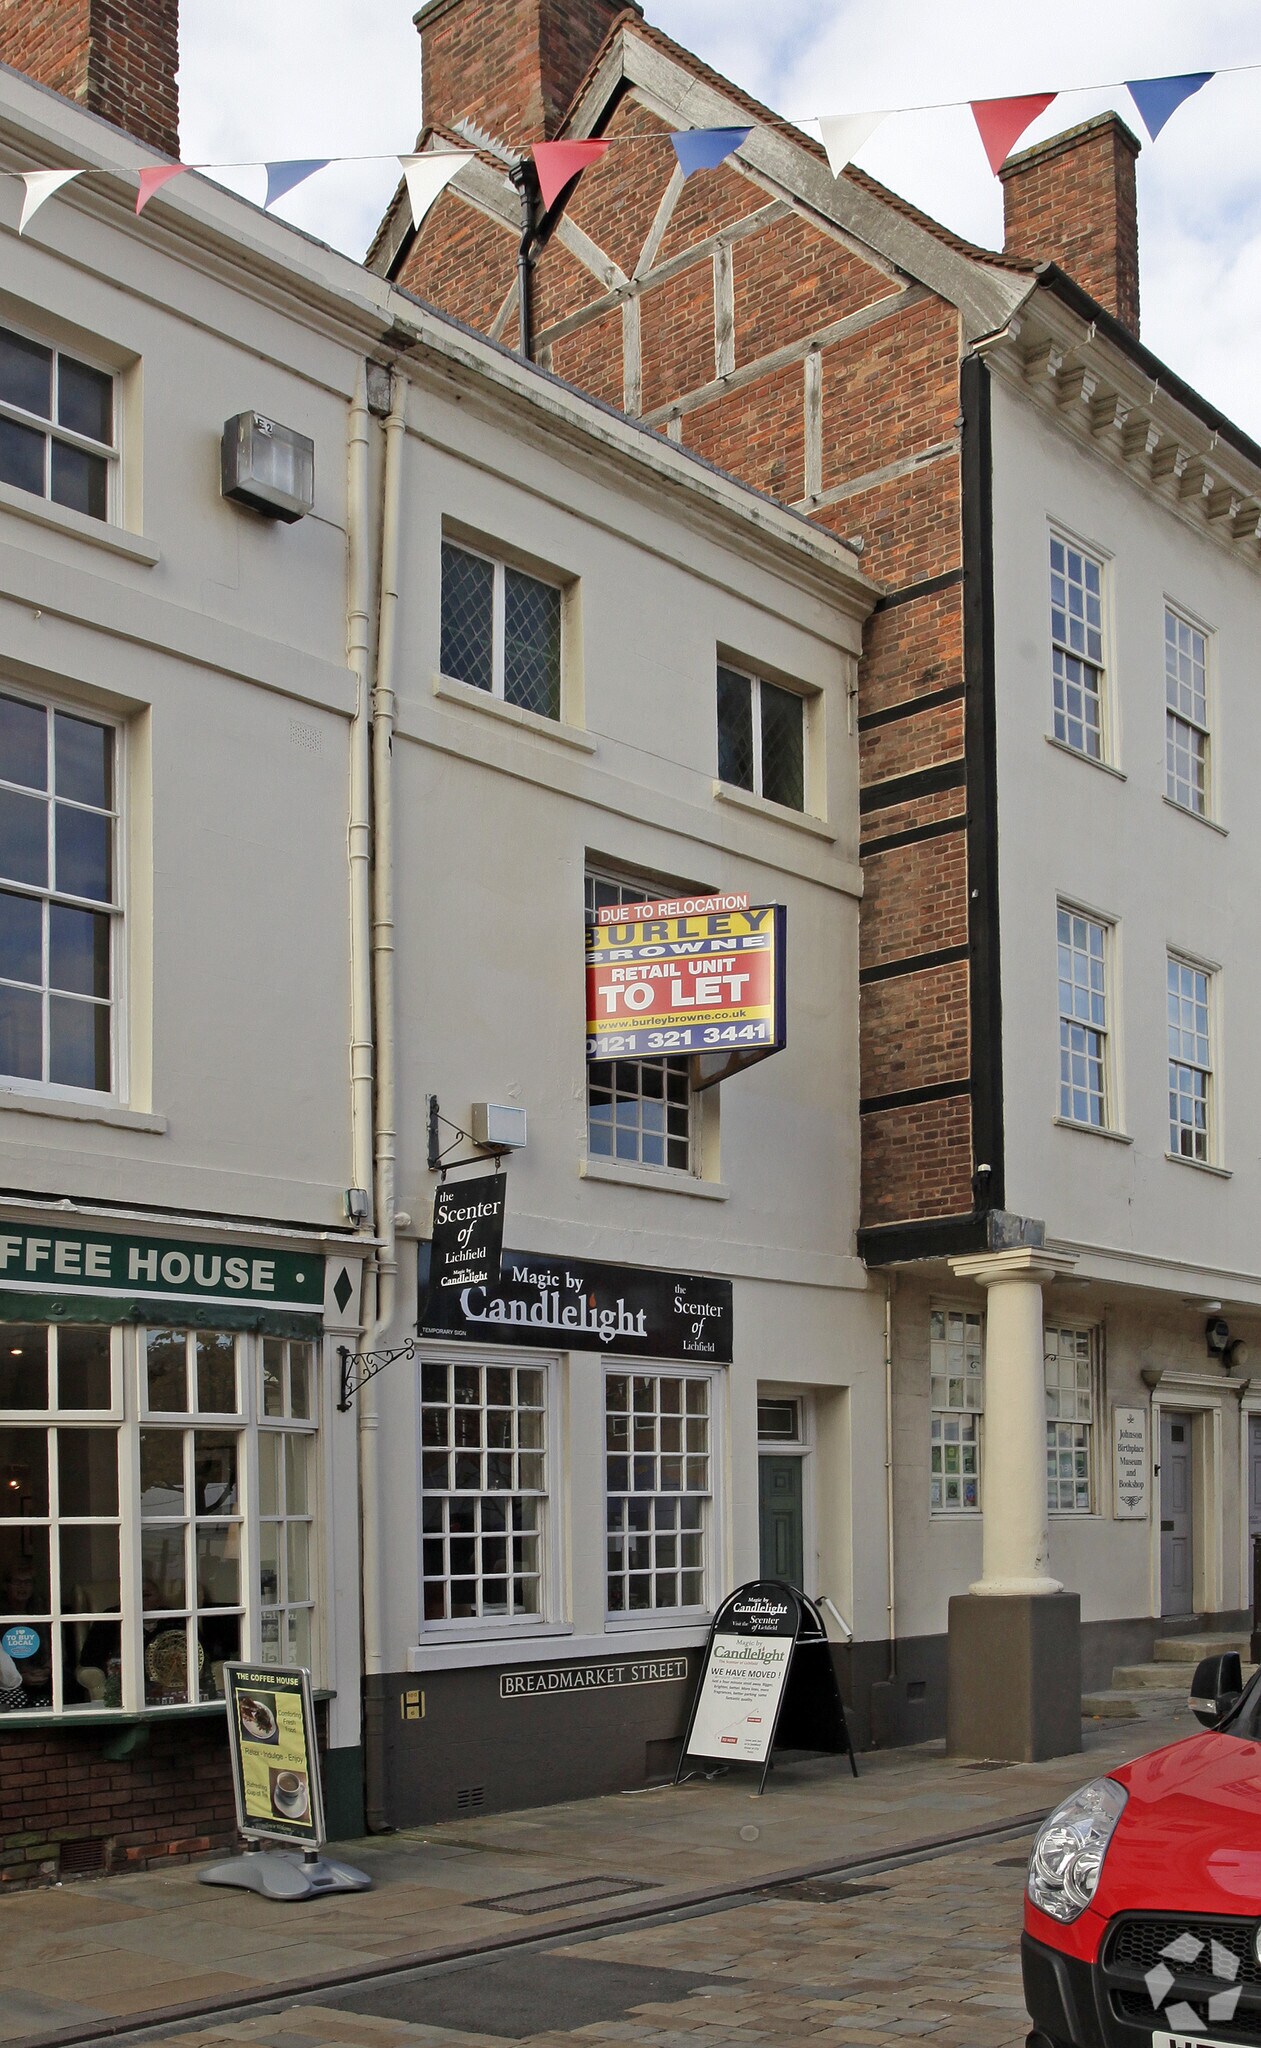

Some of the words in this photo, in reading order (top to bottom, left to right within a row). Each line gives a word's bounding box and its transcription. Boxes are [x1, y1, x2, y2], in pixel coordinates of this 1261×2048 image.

[601, 908, 630, 923] DUE
[634, 905, 653, 919] TO
[658, 895, 747, 917] RELOCATION
[611, 963, 681, 982] RETAIL
[688, 958, 736, 975] UNIT
[598, 982, 656, 1013] TO
[671, 974, 750, 1007] LET
[598, 1009, 747, 1030] www.burleybrowne.co.uk
[585, 1034, 637, 1054] 0121
[647, 1029, 692, 1048] 321
[703, 1023, 767, 1044] 3441
[440, 1191, 454, 1203] the
[437, 1201, 501, 1225] Scenter
[457, 1219, 478, 1249] of
[445, 1246, 487, 1264] Lichfield
[128, 1247, 275, 1292] HOUSE
[440, 1270, 488, 1287] Candlelight
[512, 1265, 560, 1288] Magic
[566, 1271, 584, 1293] by
[674, 1283, 687, 1295] the
[459, 1285, 648, 1344] Candlelight
[673, 1296, 724, 1318] Scenter
[422, 1327, 454, 1335] TEMPORARY
[691, 1317, 706, 1340] of
[683, 1340, 715, 1352] Lichfield
[1119, 1429, 1142, 1440] Johnson
[1117, 1443, 1144, 1454] Birthplace
[1120, 1457, 1142, 1466] Museum
[1126, 1469, 1136, 1477] and
[1118, 1480, 1144, 1490] Bookshop
[733, 1602, 787, 1616] Candlelight
[750, 1615, 780, 1625] Scenter
[751, 1623, 759, 1632] of
[736, 1639, 755, 1647] Magic
[713, 1645, 785, 1665] Candlelight
[236, 1672, 249, 1680] THE
[250, 1674, 275, 1684] COFFEE
[276, 1676, 299, 1686] HOUSE
[504, 1667, 625, 1694] BREADMARKET
[631, 1661, 684, 1682] STREET
[711, 1667, 724, 1675] WE
[725, 1668, 747, 1677] HAVE
[747, 1670, 776, 1679] MOVED
[288, 1753, 303, 1765] Enjoy
